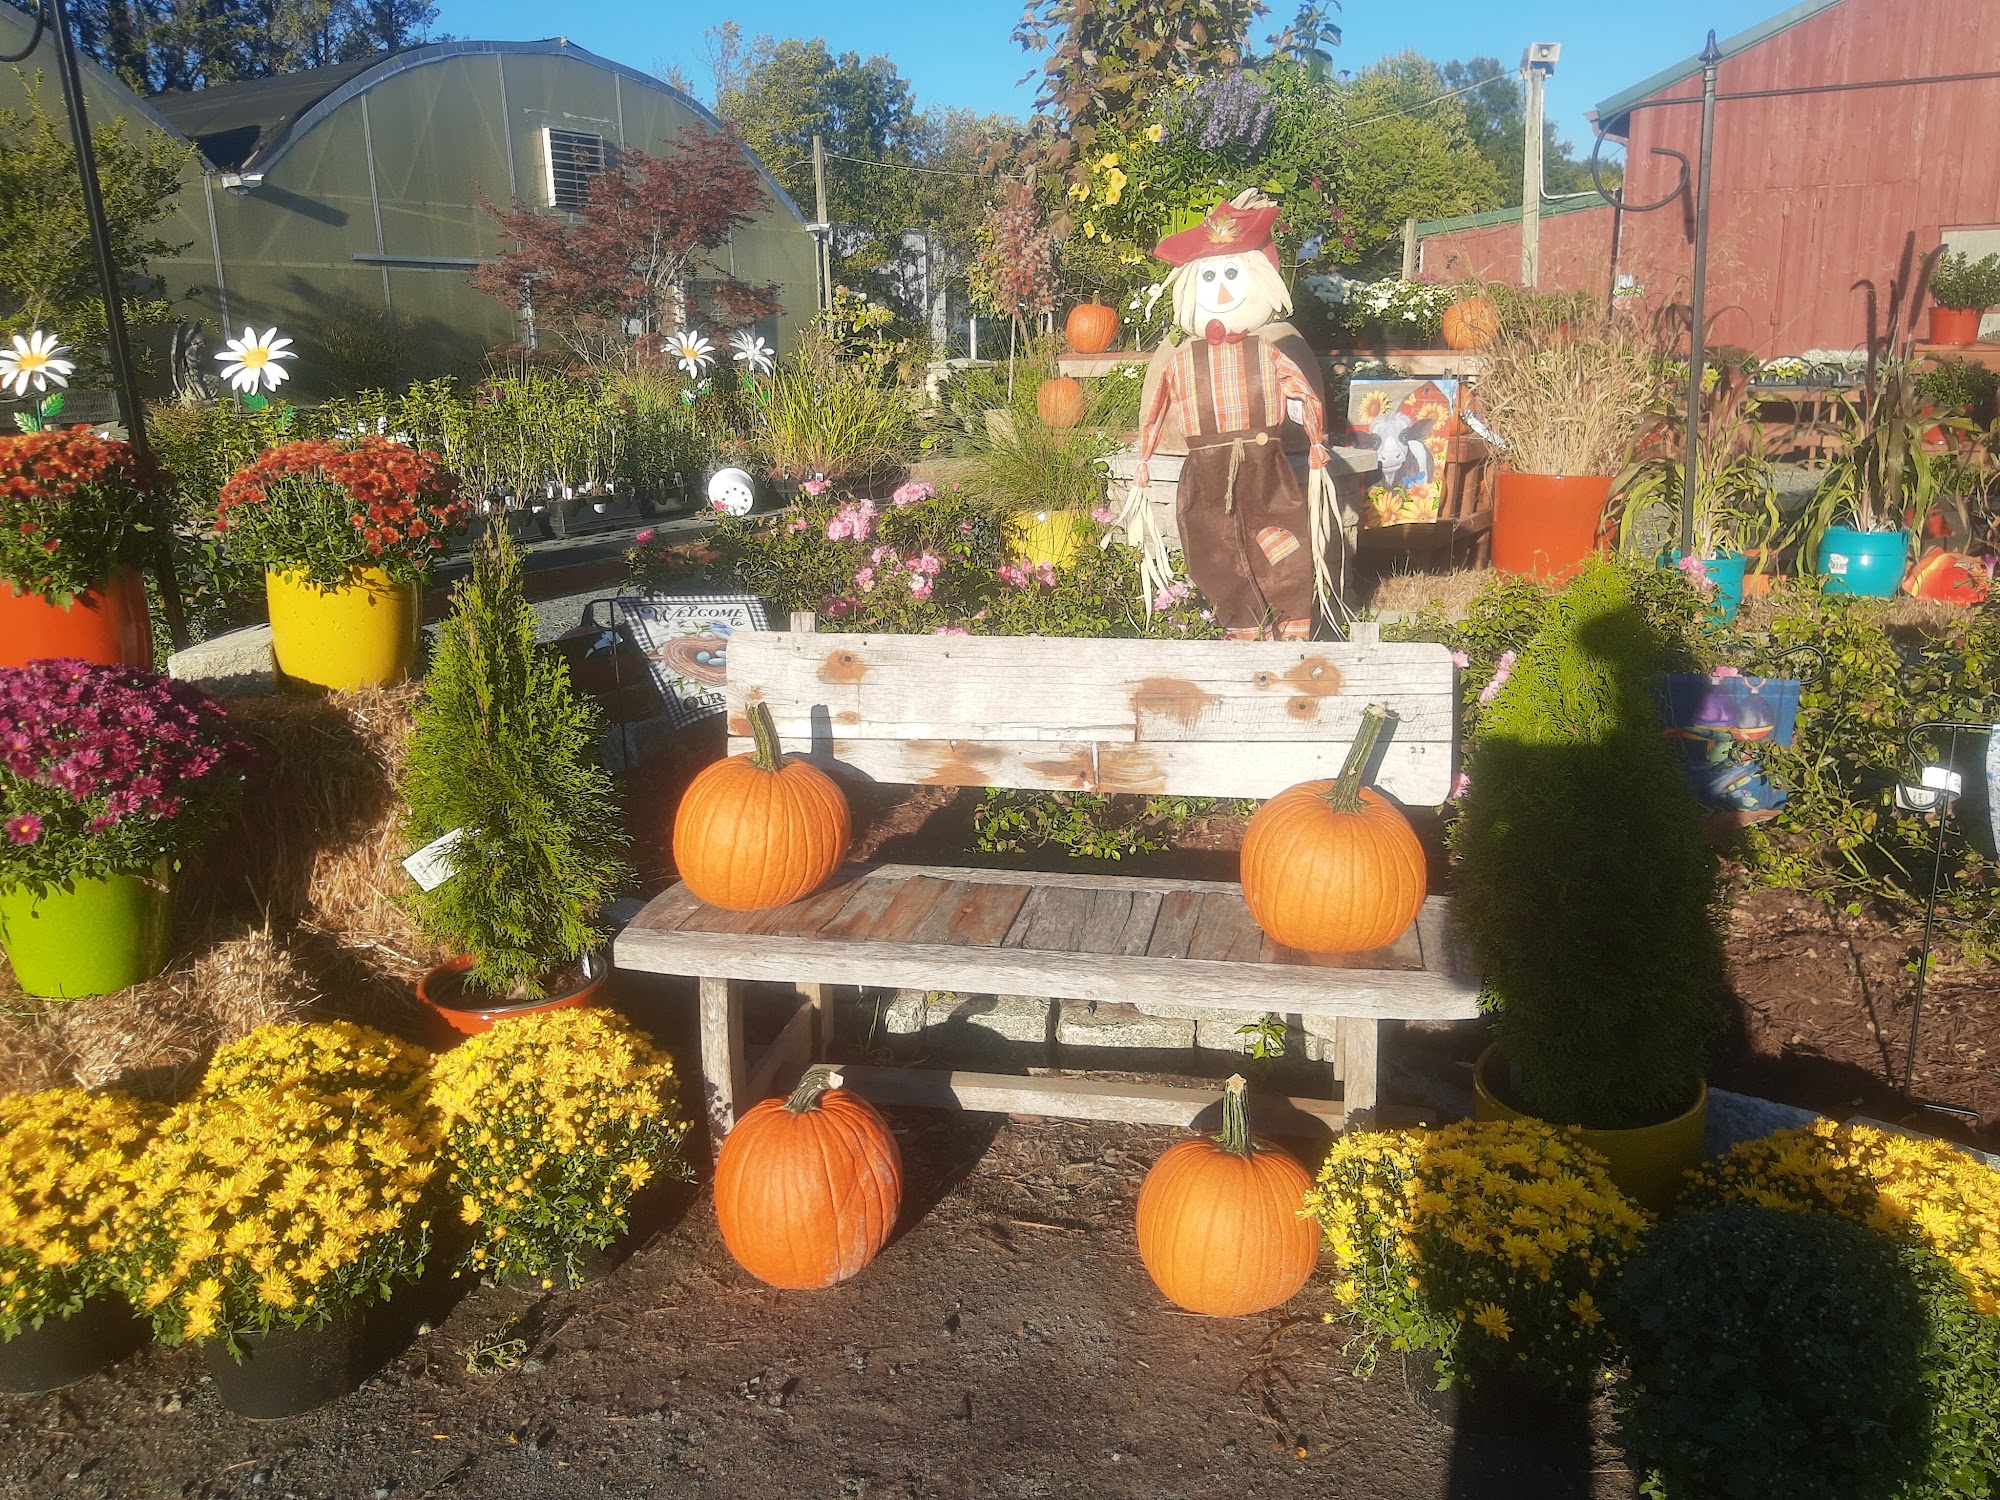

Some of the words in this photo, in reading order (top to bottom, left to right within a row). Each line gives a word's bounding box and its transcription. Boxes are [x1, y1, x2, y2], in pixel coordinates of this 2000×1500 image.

[641, 605, 744, 622] WELCOME
[730, 617, 745, 627] to
[683, 692, 724, 711] OUR
